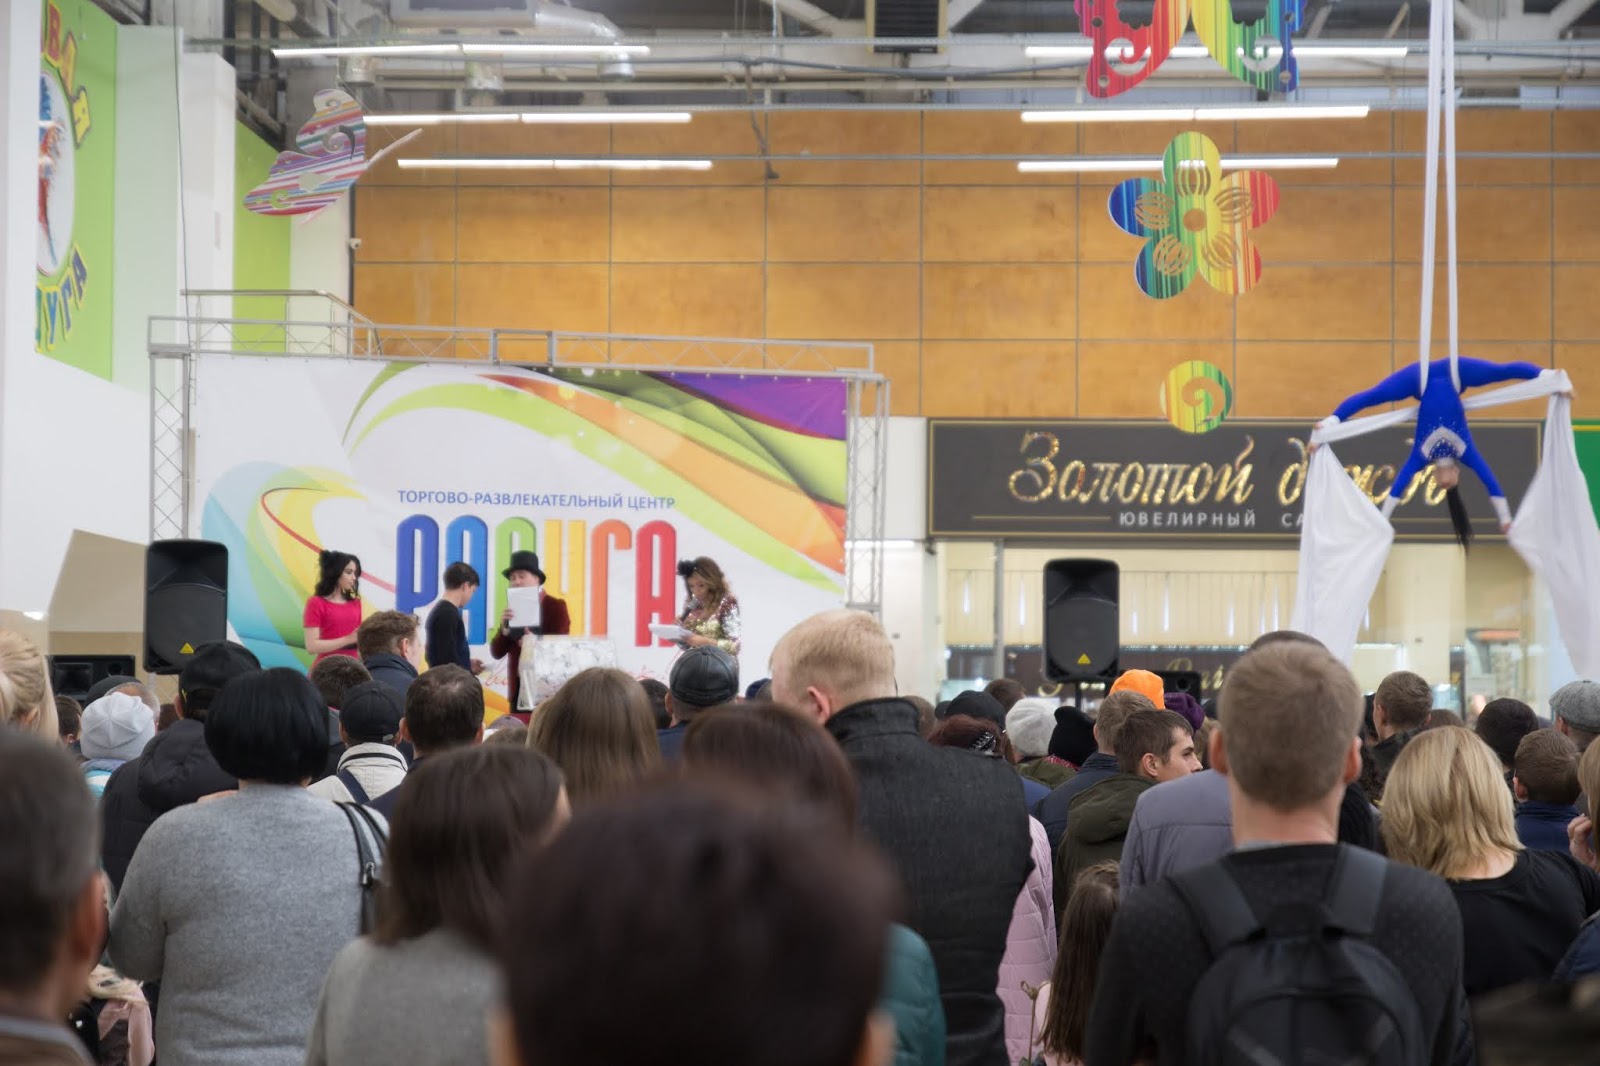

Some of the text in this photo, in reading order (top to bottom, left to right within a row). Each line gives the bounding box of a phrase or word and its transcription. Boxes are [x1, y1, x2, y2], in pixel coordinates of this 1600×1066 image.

[1008, 428, 1255, 505] Золотой
[398, 490, 676, 511] ТОРГОВО-РАЗВЛЕКАТЕЛЬНЫЙ ЦЕНТР
[1119, 509, 1256, 528] ЮВЕЛИРНЫЙ
